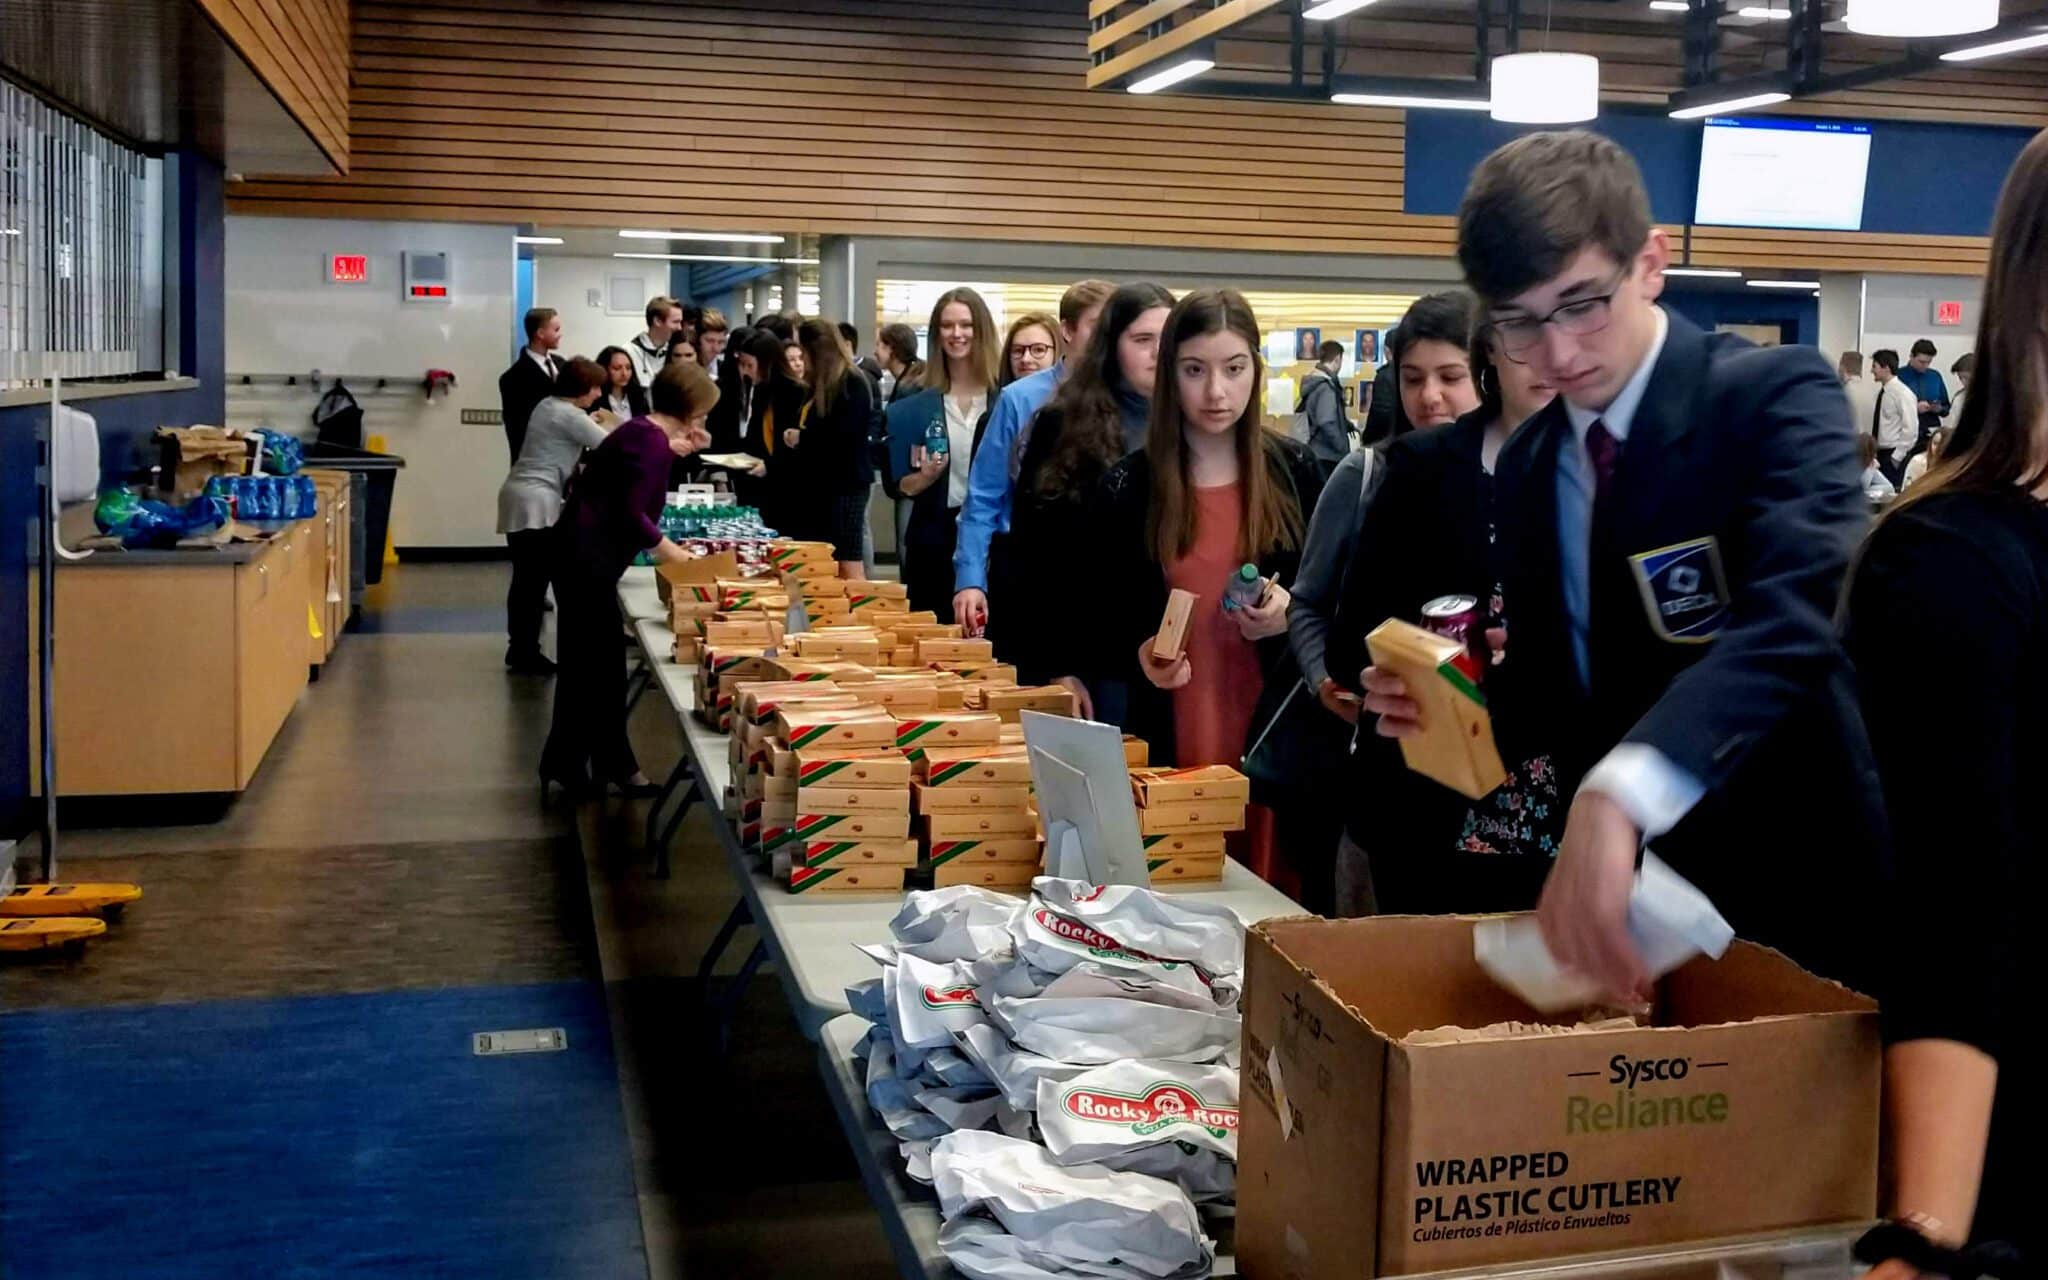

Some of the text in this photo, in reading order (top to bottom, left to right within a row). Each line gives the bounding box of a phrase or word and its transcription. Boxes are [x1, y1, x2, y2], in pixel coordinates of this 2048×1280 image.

[1043, 912, 1111, 949] Rocky
[1609, 1054, 1689, 1089] Sysco
[1077, 1094, 1150, 1123] Rocky
[1567, 1090, 1729, 1135] Reliance
[1416, 1151, 1569, 1187] WRAPPED
[1415, 1176, 1682, 1224] PLASTIC CUTLERY
[1413, 1211, 1632, 1243] Cubiertos de Plástico Envueltos
